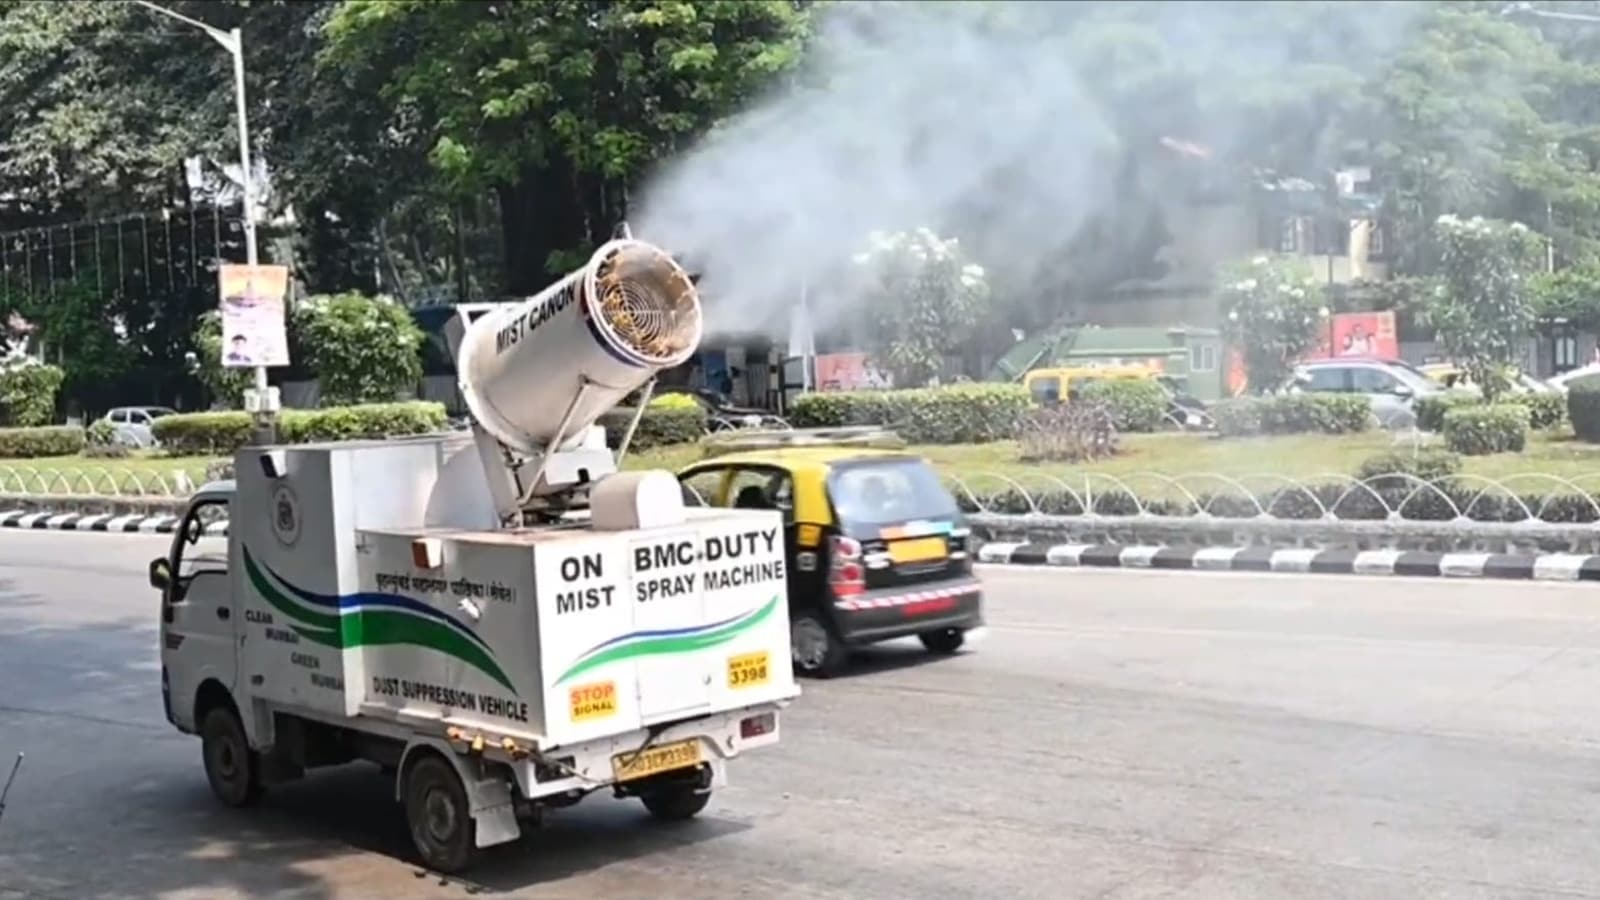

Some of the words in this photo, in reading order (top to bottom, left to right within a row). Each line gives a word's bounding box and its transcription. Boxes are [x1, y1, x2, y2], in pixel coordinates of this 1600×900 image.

[497, 314, 527, 353] MIST
[528, 281, 577, 331] CANON
[561, 553, 603, 582] ON
[634, 541, 694, 572] BMC
[705, 527, 777, 561] DUTY
[556, 585, 615, 614] MIST
[636, 574, 695, 602] SPRAY
[704, 560, 784, 591] MACHINE
[245, 609, 273, 624] CLEAN
[730, 665, 767, 685] 3398
[373, 676, 398, 696] DUST
[402, 679, 476, 710] SUPPRESSION
[479, 694, 529, 722] VEHICLE
[570, 684, 614, 704] STOP
[574, 701, 614, 717] SIGNAL
